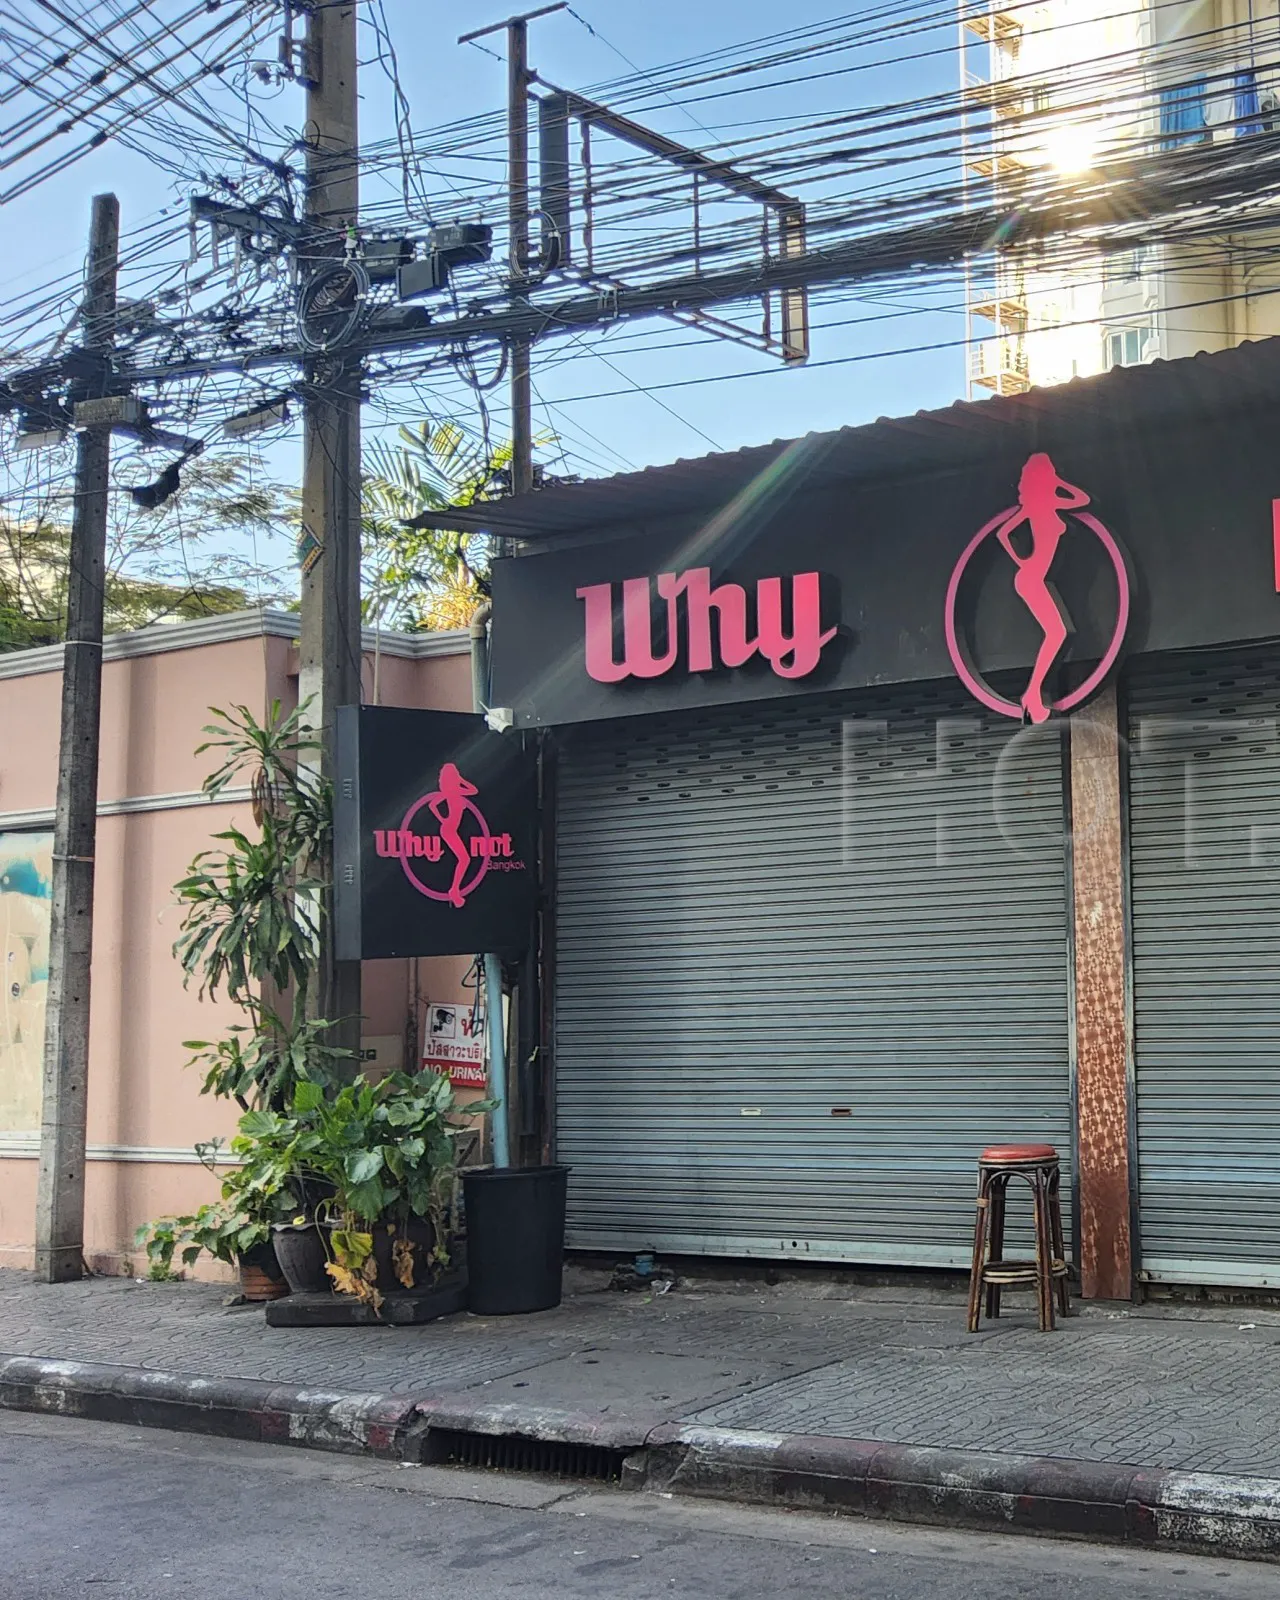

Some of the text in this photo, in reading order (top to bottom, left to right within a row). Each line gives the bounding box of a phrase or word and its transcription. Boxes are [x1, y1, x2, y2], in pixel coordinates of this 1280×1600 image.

[576, 567, 838, 683] Why
[373, 830, 515, 862] Why not
[487, 859, 527, 873] Bangkok
